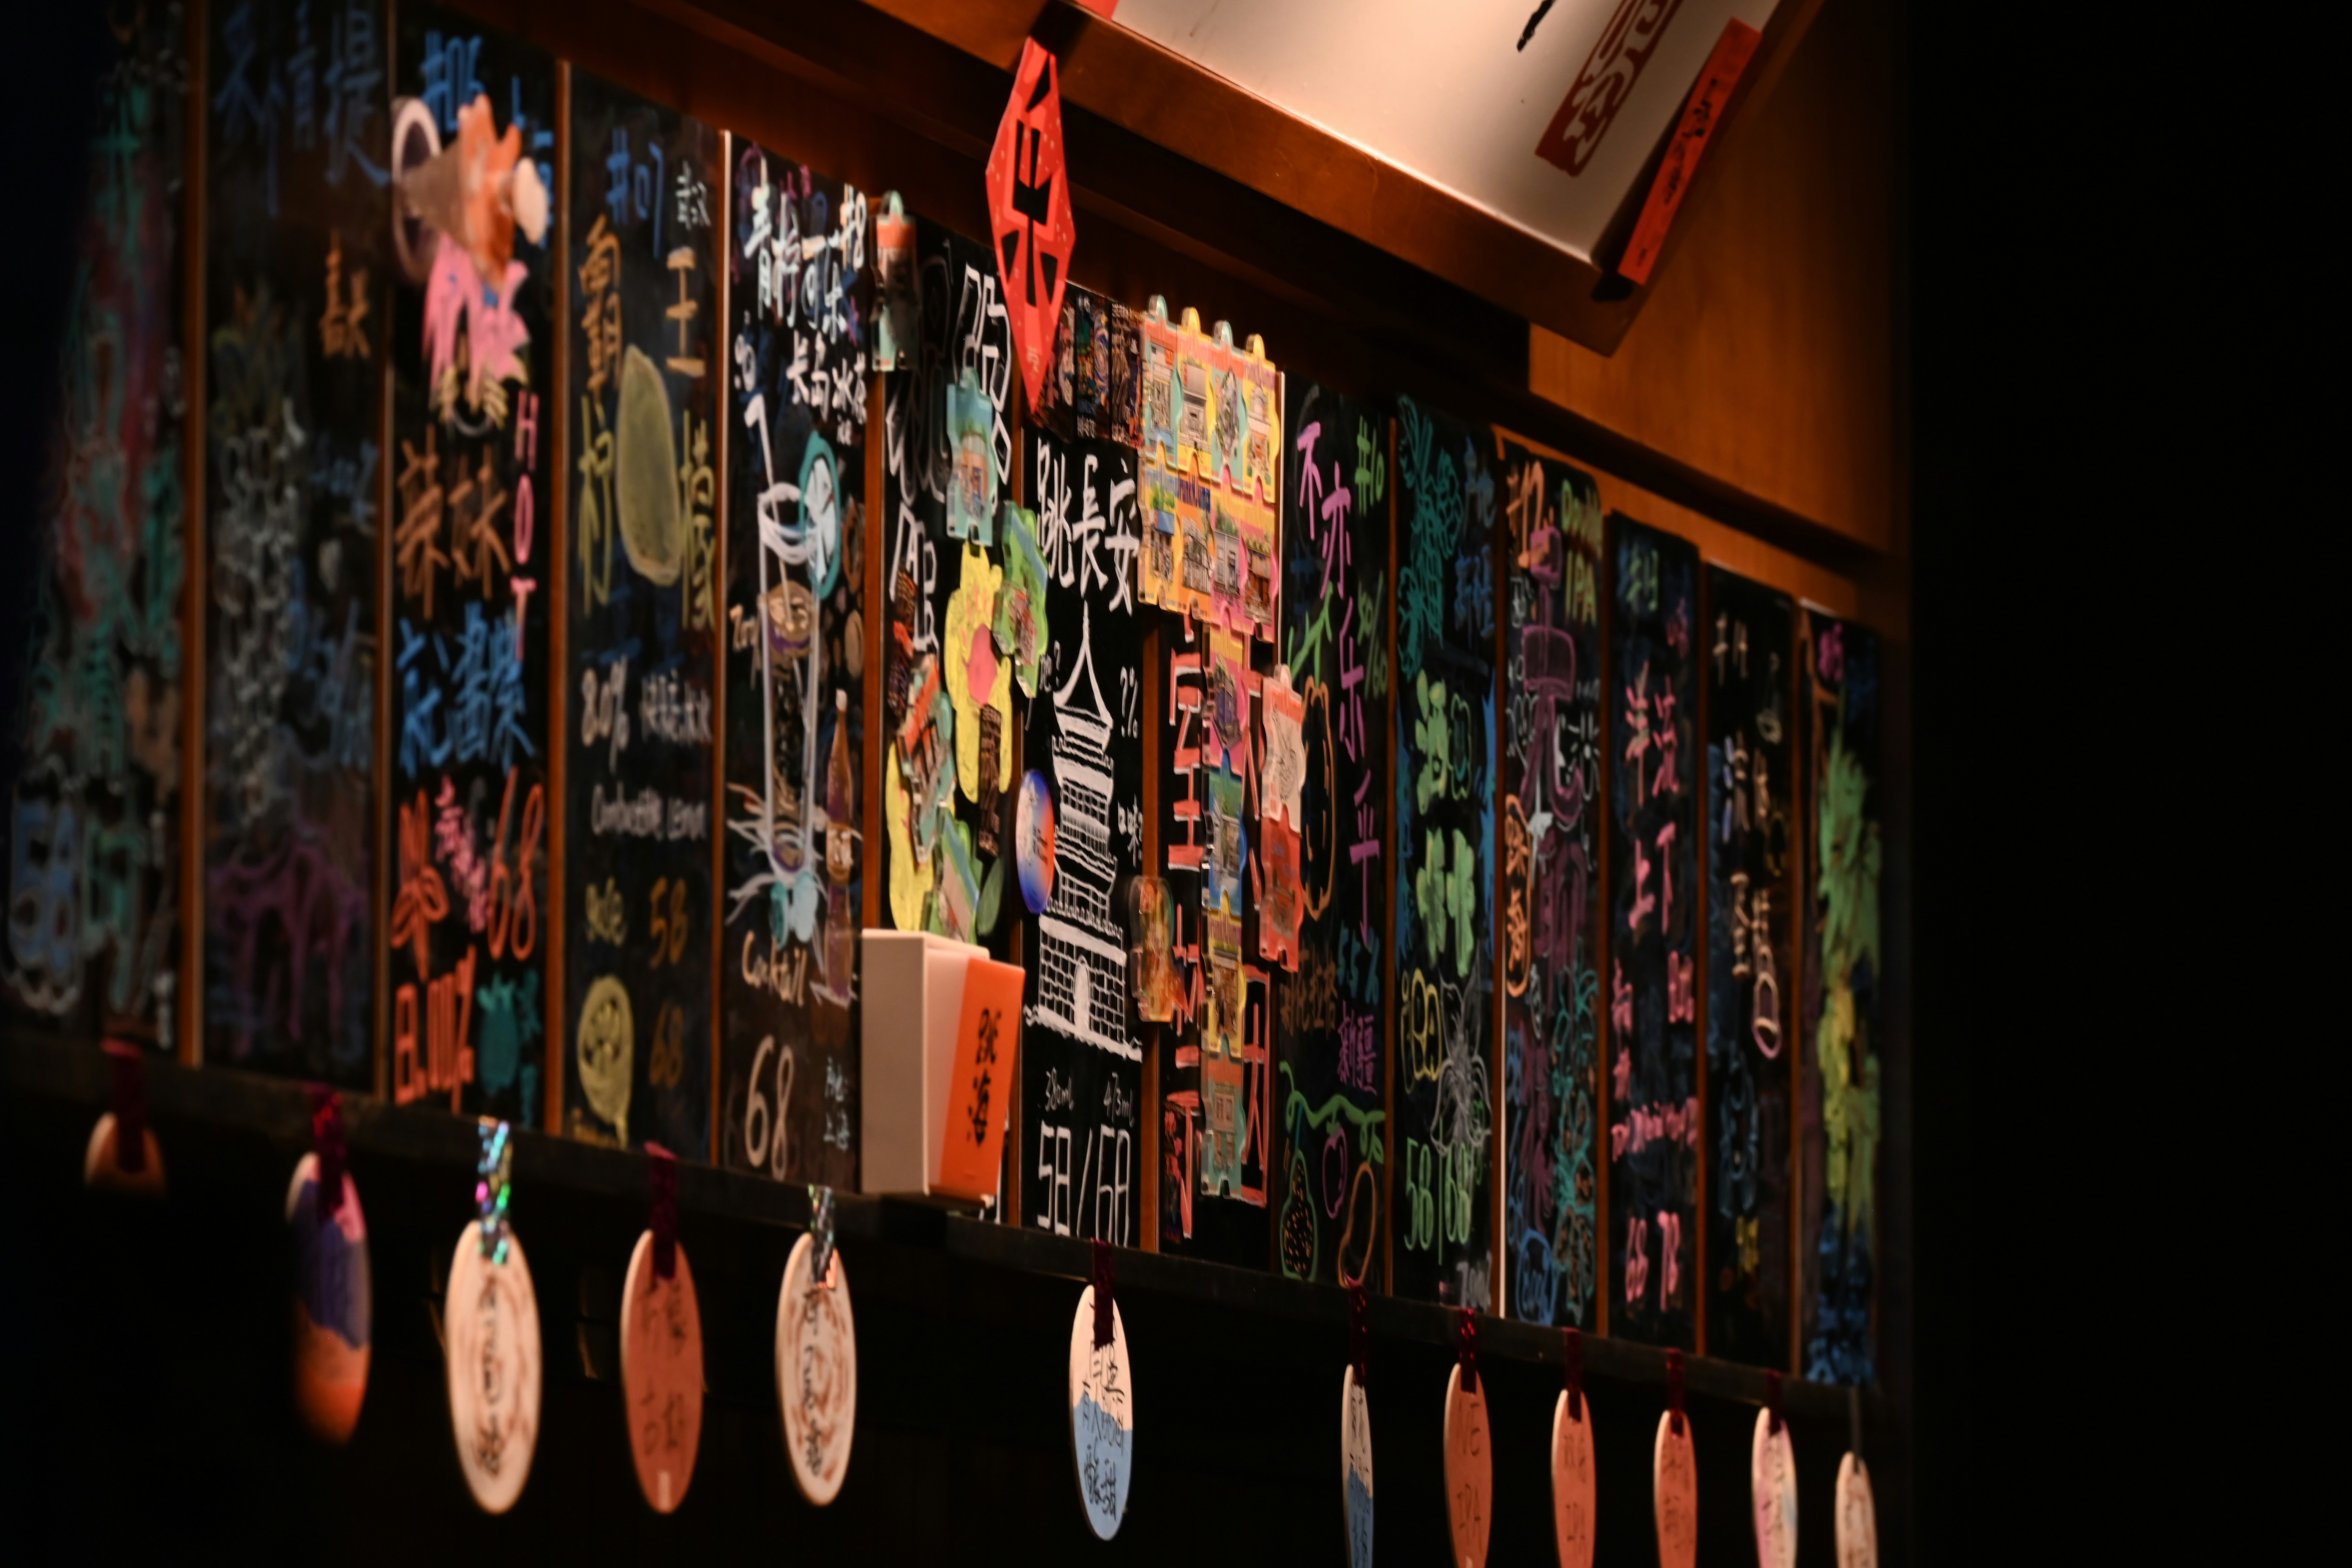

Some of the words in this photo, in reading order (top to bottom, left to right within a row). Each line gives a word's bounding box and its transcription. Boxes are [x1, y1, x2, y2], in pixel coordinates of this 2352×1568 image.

[1354, 414, 1386, 516] #10
[1296, 419, 1381, 948] 不亦乐乎
[744, 1034, 795, 1182] 68
[1337, 999, 1378, 1097] 新疆
[1037, 1119, 1131, 1248] 58/68
